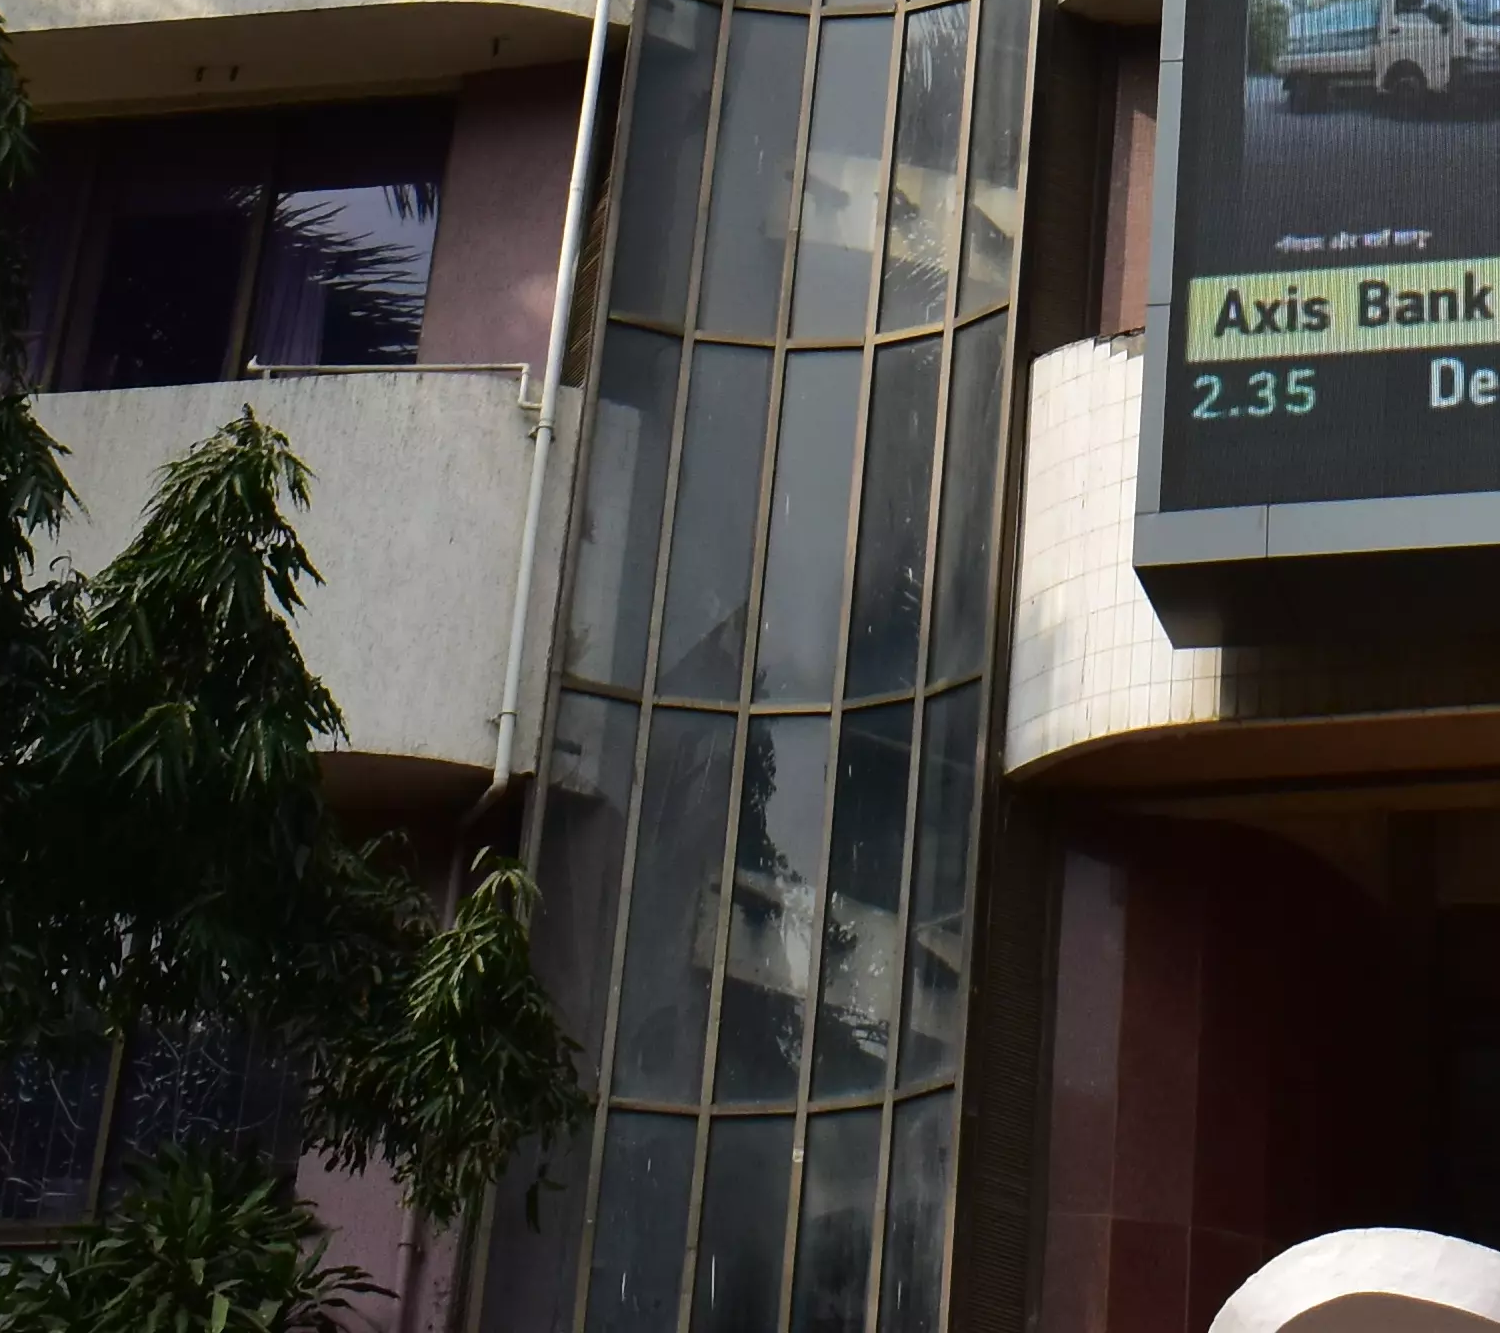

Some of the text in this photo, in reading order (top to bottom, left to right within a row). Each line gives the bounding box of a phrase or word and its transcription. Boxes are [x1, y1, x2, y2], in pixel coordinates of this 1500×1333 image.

[1212, 286, 1332, 339] Axis
[1356, 270, 1495, 329] Bank
[1191, 368, 1319, 420] 2.35
